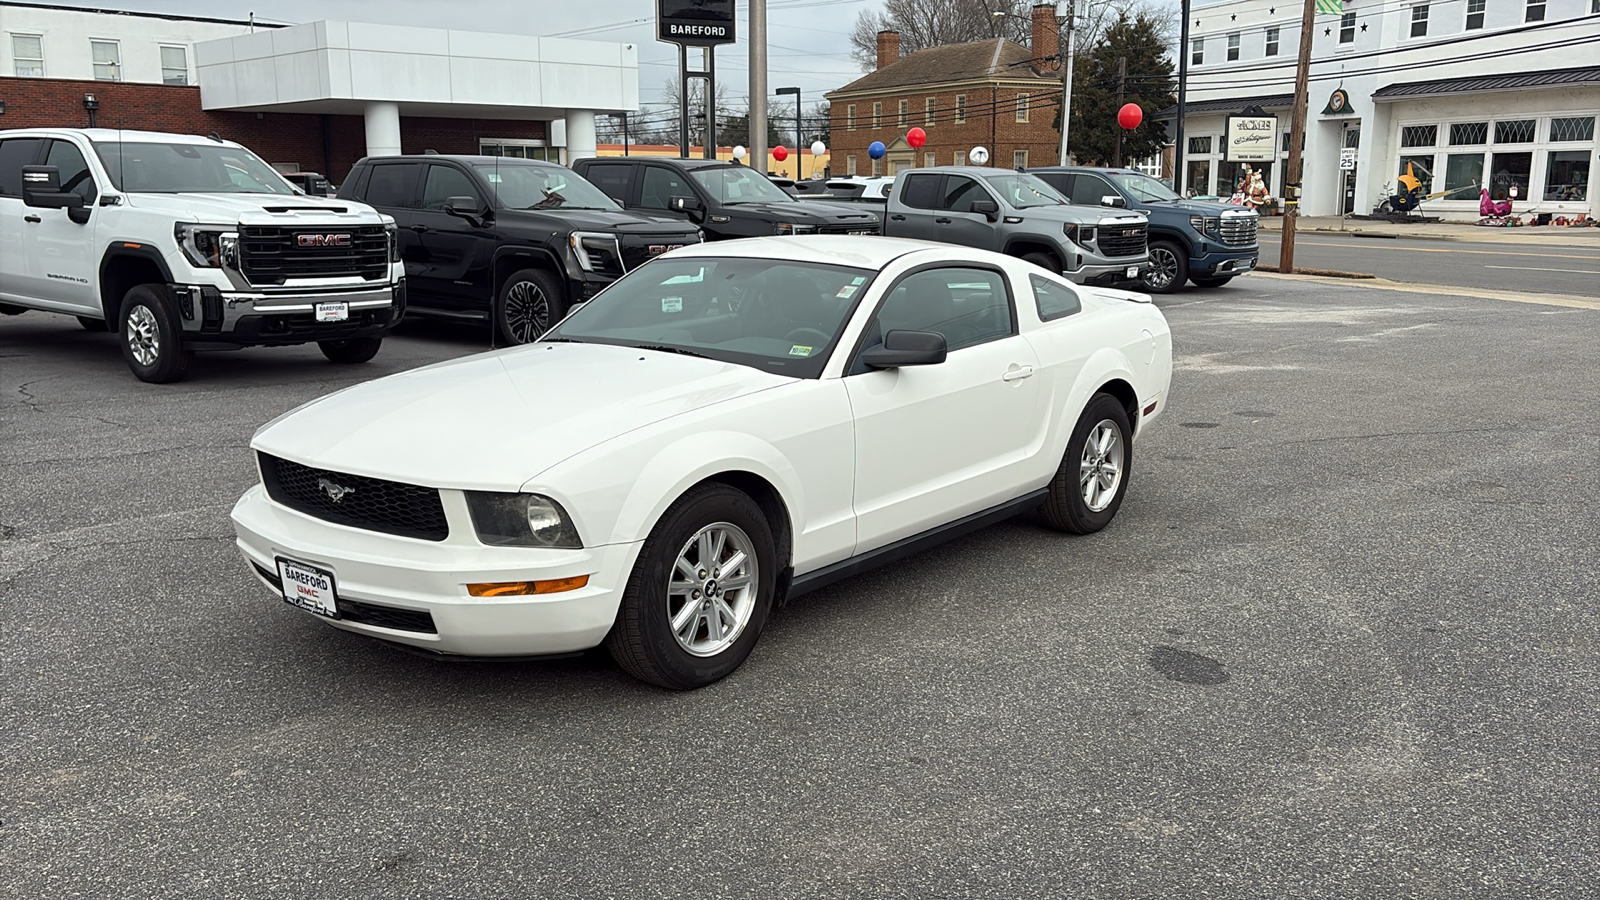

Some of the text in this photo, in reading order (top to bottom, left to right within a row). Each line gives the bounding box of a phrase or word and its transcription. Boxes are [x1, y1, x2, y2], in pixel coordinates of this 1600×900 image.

[670, 24, 726, 36] BAREFORD
[1341, 159, 1353, 168] 25
[298, 234, 351, 246] GMC
[285, 567, 328, 591] BAREFORD
[297, 584, 320, 598] GMC
